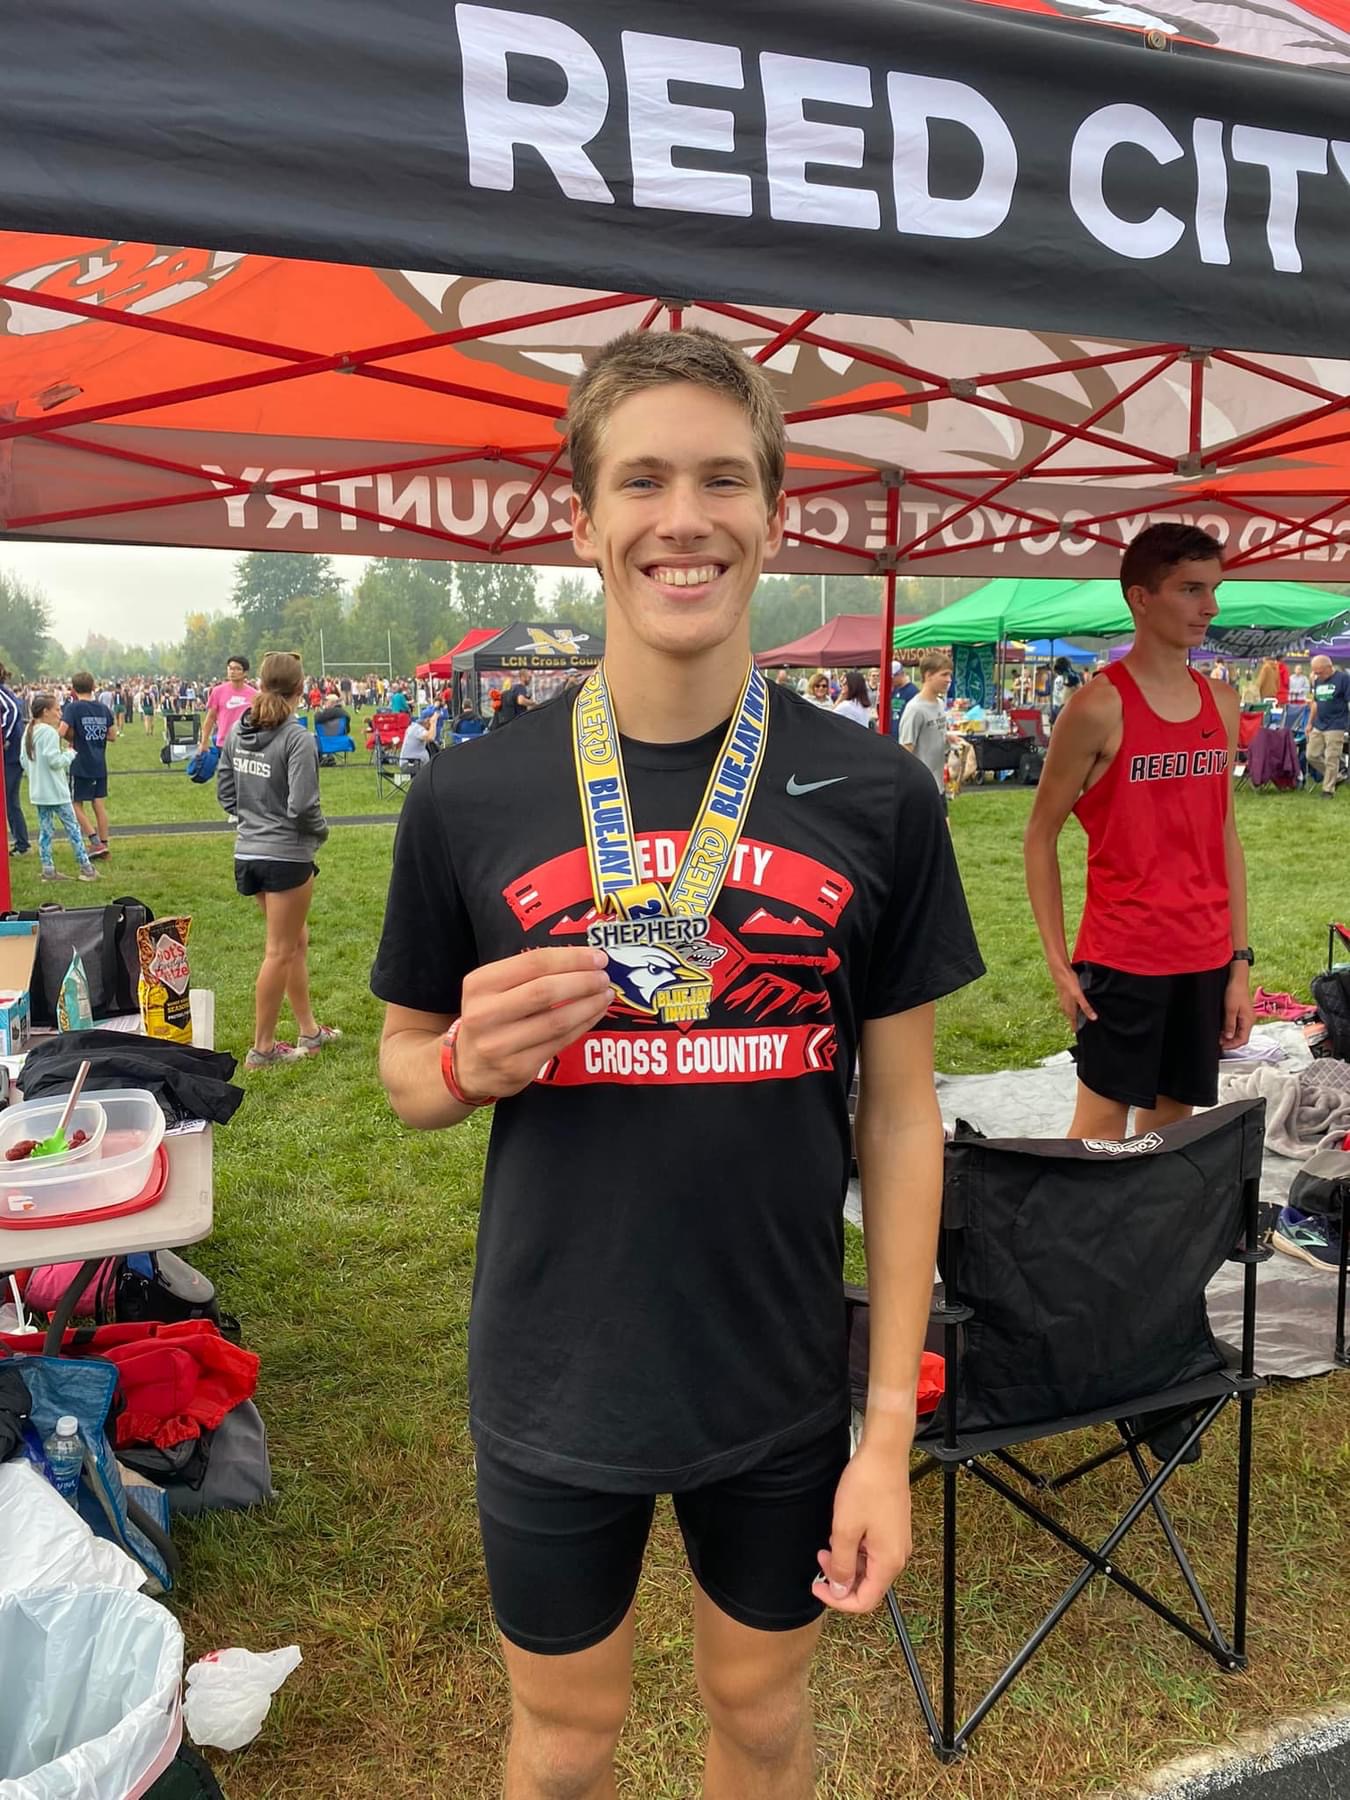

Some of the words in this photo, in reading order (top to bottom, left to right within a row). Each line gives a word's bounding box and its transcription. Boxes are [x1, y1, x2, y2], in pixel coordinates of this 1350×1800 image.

[455, 3, 1018, 240] REED
[1069, 103, 1350, 273] CIT
[501, 656, 528, 667] LCN
[531, 656, 567, 667] Cross
[894, 647, 934, 660] AVISON
[84, 724, 108, 741] XC
[709, 716, 764, 820] BLUEJAY
[1130, 752, 1188, 782] REED
[1192, 749, 1228, 776] CITY
[587, 777, 634, 876] BLUEJAY
[640, 838, 676, 880] ED
[731, 847, 773, 886] TY
[590, 918, 708, 947] SHEPHERD
[656, 985, 712, 1006] BLUEJAY
[664, 1004, 710, 1022] INVITE
[584, 1036, 668, 1076] CROSS
[676, 1034, 788, 1074] COUNTRY
